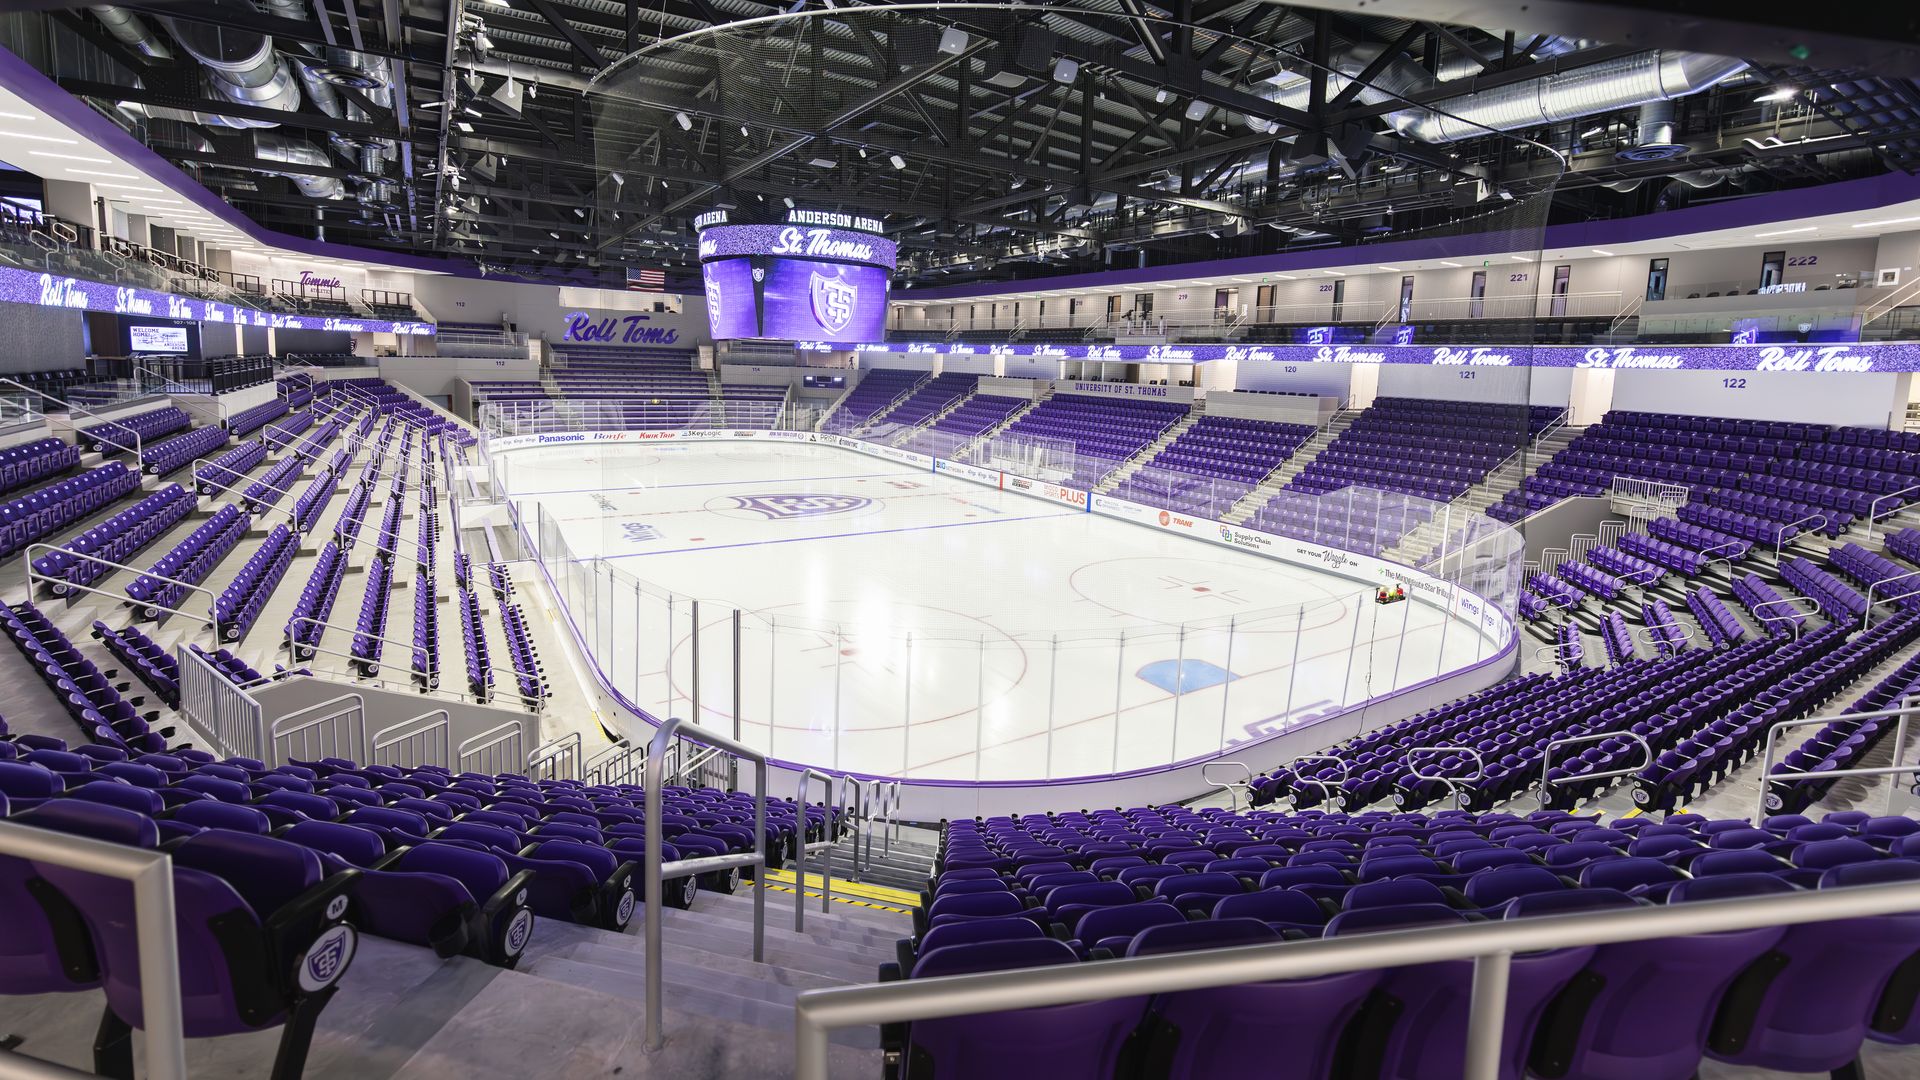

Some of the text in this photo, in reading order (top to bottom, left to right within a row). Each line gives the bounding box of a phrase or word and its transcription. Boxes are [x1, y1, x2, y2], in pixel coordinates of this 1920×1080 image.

[703, 210, 727, 225] ARENA
[788, 210, 884, 233] ANDERSON ARENA
[806, 229, 873, 260] Thomas
[1788, 256, 1817, 267] 222
[300, 271, 340, 288] Tommie
[1510, 274, 1528, 282] 221
[40, 273, 88, 309] Roll Toms
[1319, 284, 1333, 292] 220
[271, 314, 302, 329] Roll Toms
[333, 319, 363, 331] Thomas
[392, 322, 430, 335] Roll Toms
[563, 311, 679, 344] Roll Toms
[1087, 345, 1121, 358] Roll Toms
[1161, 346, 1194, 359] Thomas
[1225, 346, 1275, 361] Roll Toms
[1333, 347, 1386, 363] Thomas
[1432, 348, 1512, 366] Roll Toms
[1611, 348, 1683, 368] Thomas
[1756, 347, 1873, 372] Roll Toms
[1459, 371, 1476, 379] 121
[1075, 383, 1167, 396] UNIVERSITY OF ST. THOMAS
[1722, 378, 1747, 389] 122
[538, 433, 585, 443] Panasonic
[1060, 488, 1085, 505] PLUS
[1173, 518, 1193, 527] TRANE
[1234, 532, 1271, 545] Supply Chain
[1385, 569, 1394, 579] The
[1424, 582, 1436, 593] Star
[331, 901, 344, 914] M
